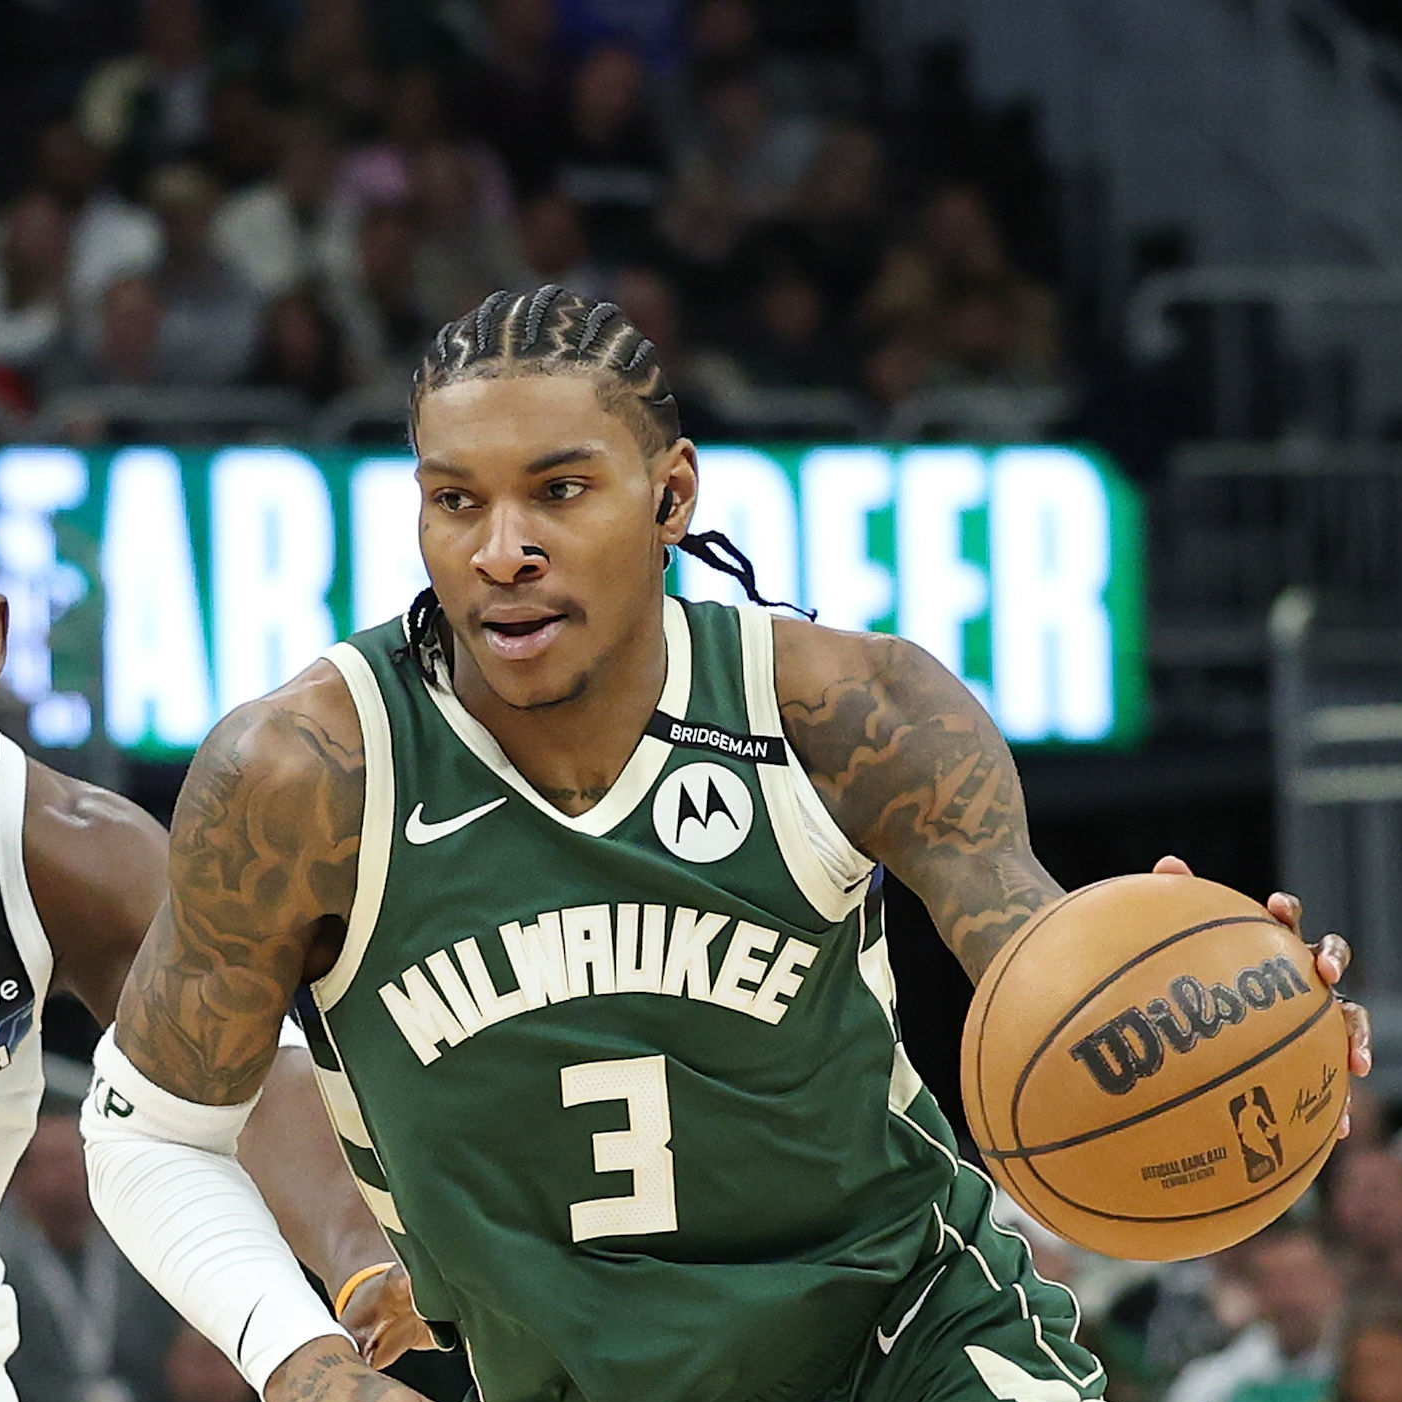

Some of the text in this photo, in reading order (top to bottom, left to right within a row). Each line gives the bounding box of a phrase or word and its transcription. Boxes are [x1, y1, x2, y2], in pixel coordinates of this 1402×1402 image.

[669, 723, 768, 759] BRIDGEMAN
[378, 903, 820, 1066] MILWAUKEE
[1068, 954, 1312, 1096] Wilson
[560, 1054, 678, 1243] 3
